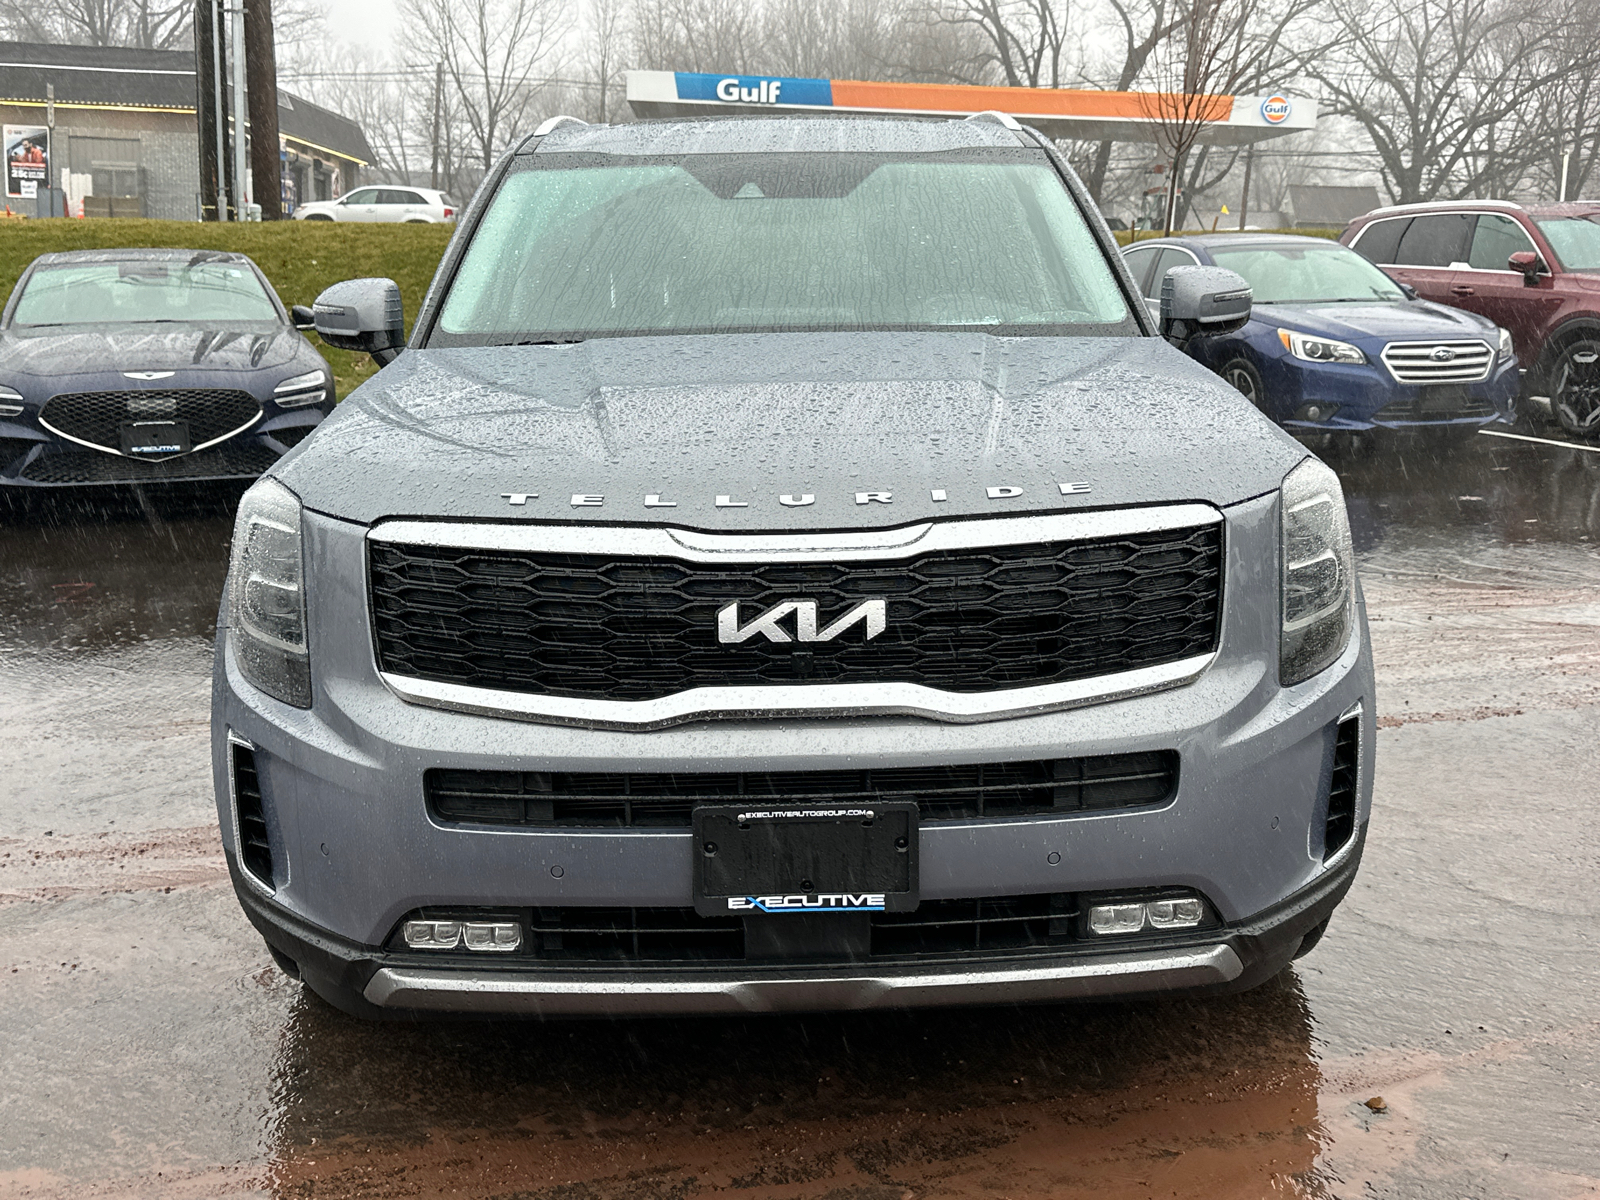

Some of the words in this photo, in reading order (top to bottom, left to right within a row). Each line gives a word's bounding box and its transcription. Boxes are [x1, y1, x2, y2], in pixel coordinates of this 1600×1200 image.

[716, 78, 781, 103] Gulf
[1264, 104, 1288, 113] Gulf
[501, 481, 1092, 507] TELLURIDE
[717, 599, 887, 644] KIA
[745, 809, 867, 819] EXECUTIVEAUTOGROUP.COM
[727, 894, 886, 910] EXECUTIVE
